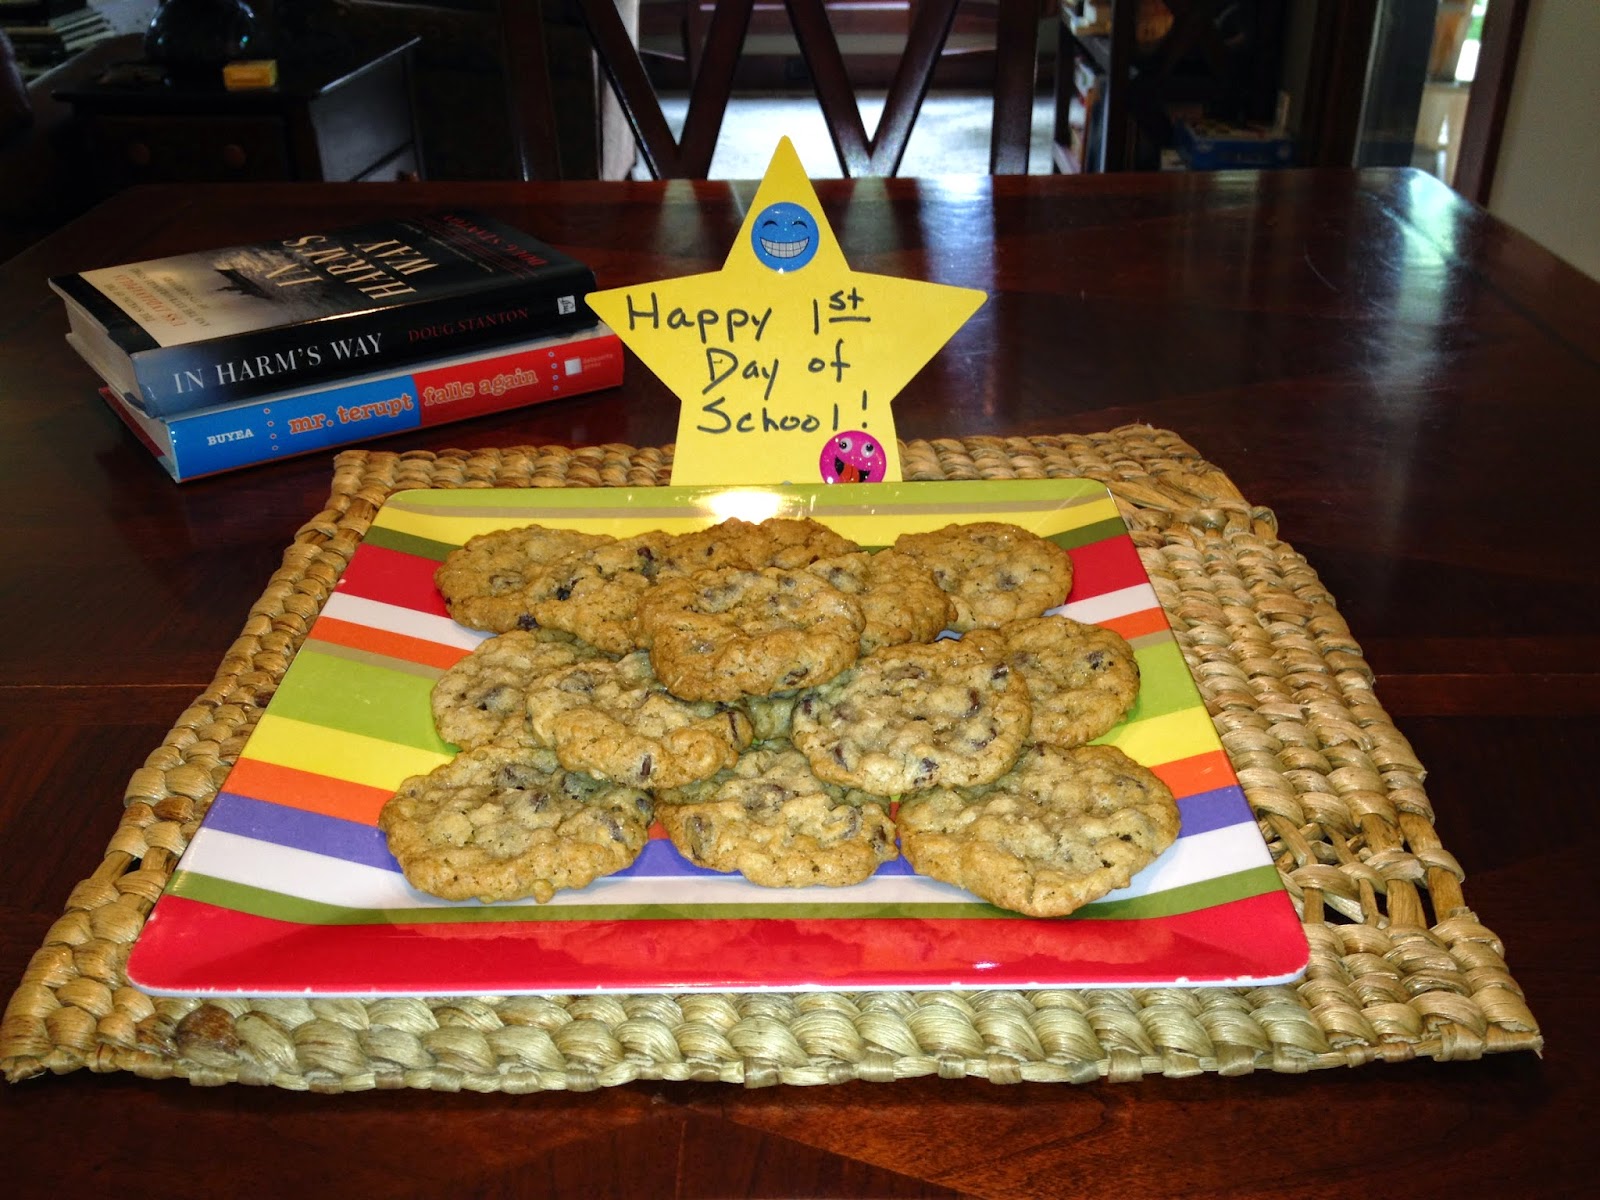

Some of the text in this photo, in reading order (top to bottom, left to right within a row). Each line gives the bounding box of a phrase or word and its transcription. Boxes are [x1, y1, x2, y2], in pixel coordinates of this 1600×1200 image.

[265, 263, 324, 288] IN
[282, 234, 418, 300] HARM'S
[353, 239, 440, 276] WAY
[407, 307, 529, 342] DOUG STANTON
[627, 292, 772, 344] Happy
[173, 332, 382, 394] IN HARM'S WAY
[701, 338, 851, 401] Day of
[288, 368, 539, 435] mr. terupt falls again
[207, 428, 255, 447] BUYEA
